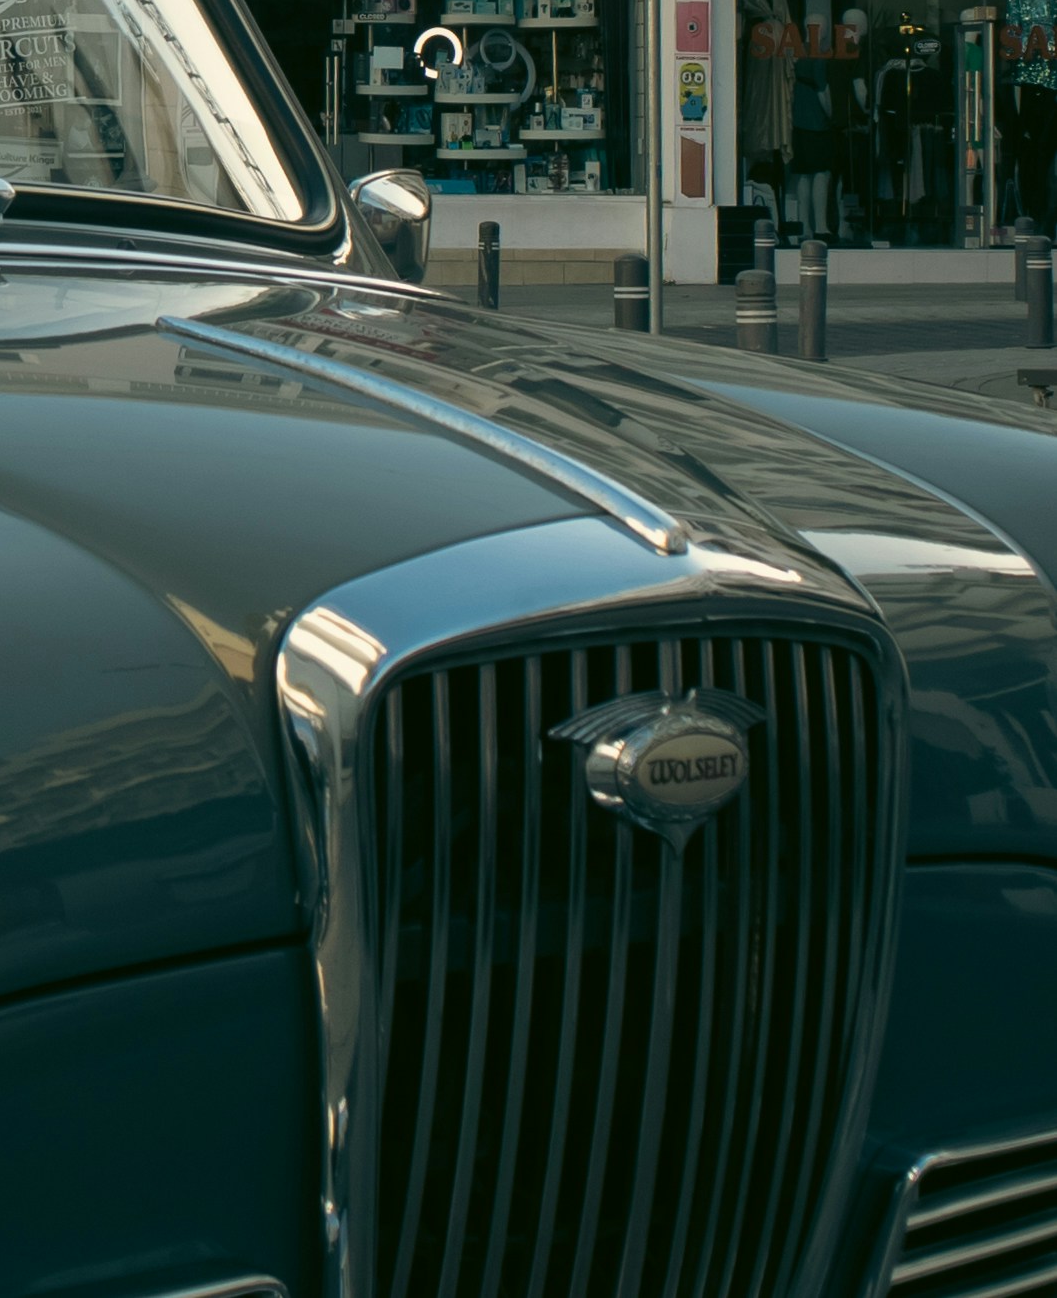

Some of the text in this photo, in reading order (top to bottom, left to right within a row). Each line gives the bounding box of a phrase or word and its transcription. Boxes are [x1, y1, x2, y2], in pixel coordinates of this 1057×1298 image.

[751, 23, 860, 59] SALE
[999, 23, 1057, 61] SA
[19, 59, 41, 72] FOR
[43, 56, 68, 68] MEN
[42, 71, 54, 84] &
[648, 755, 738, 784] WOLSELEY
